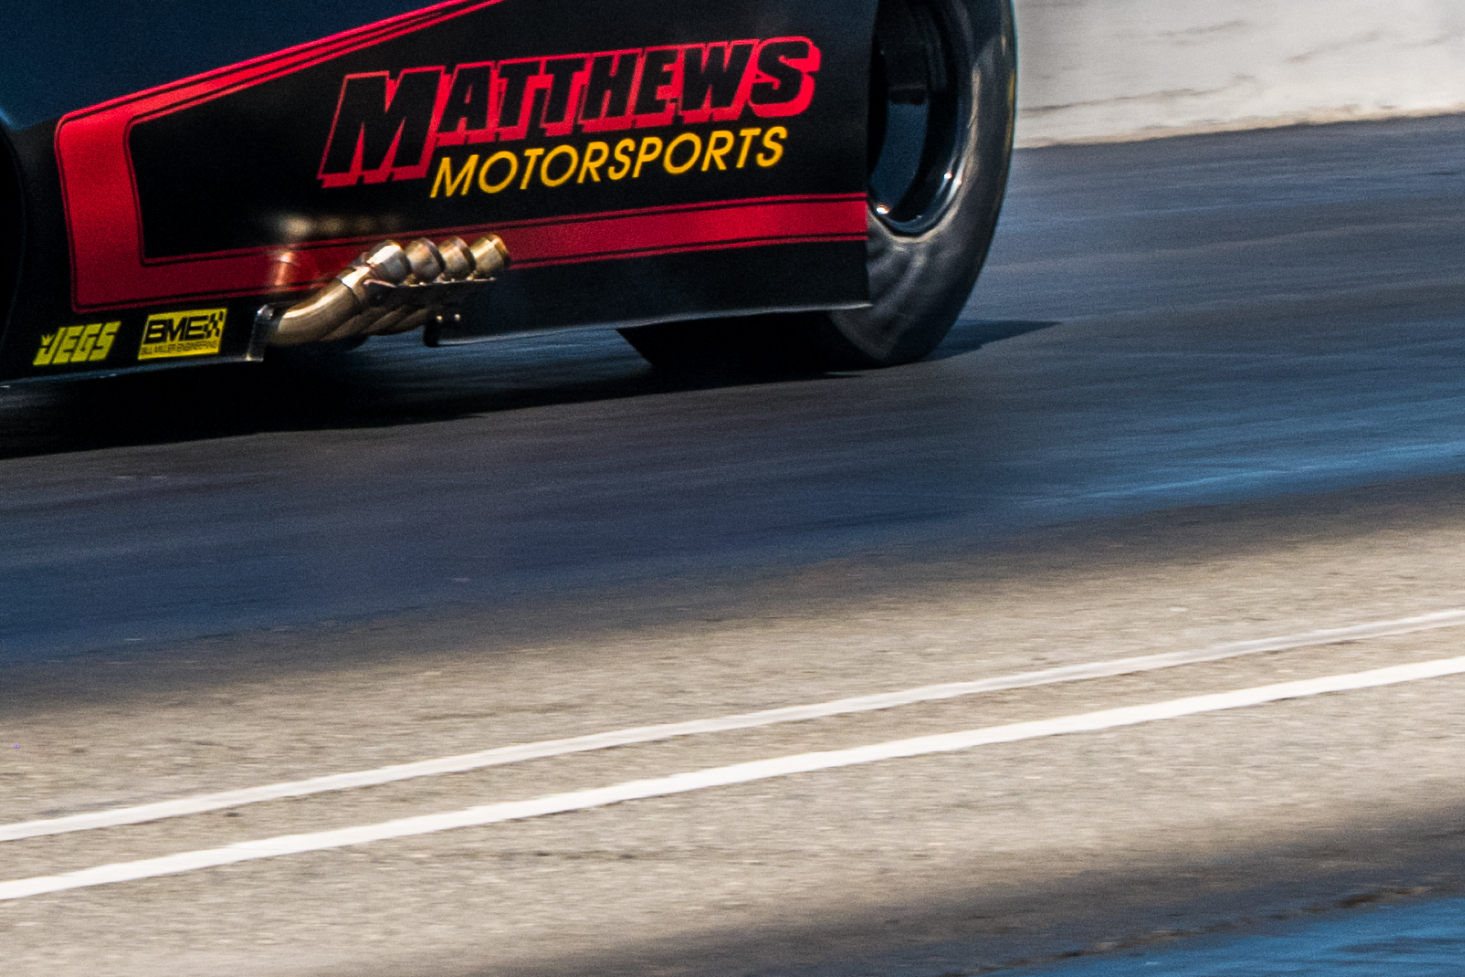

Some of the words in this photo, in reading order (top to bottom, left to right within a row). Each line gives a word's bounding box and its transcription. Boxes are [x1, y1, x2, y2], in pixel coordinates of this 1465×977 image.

[317, 36, 822, 189] MATTHEWS
[430, 125, 788, 198] MOTORSPORTS
[33, 321, 122, 366] JEGS
[142, 314, 214, 345] BME
